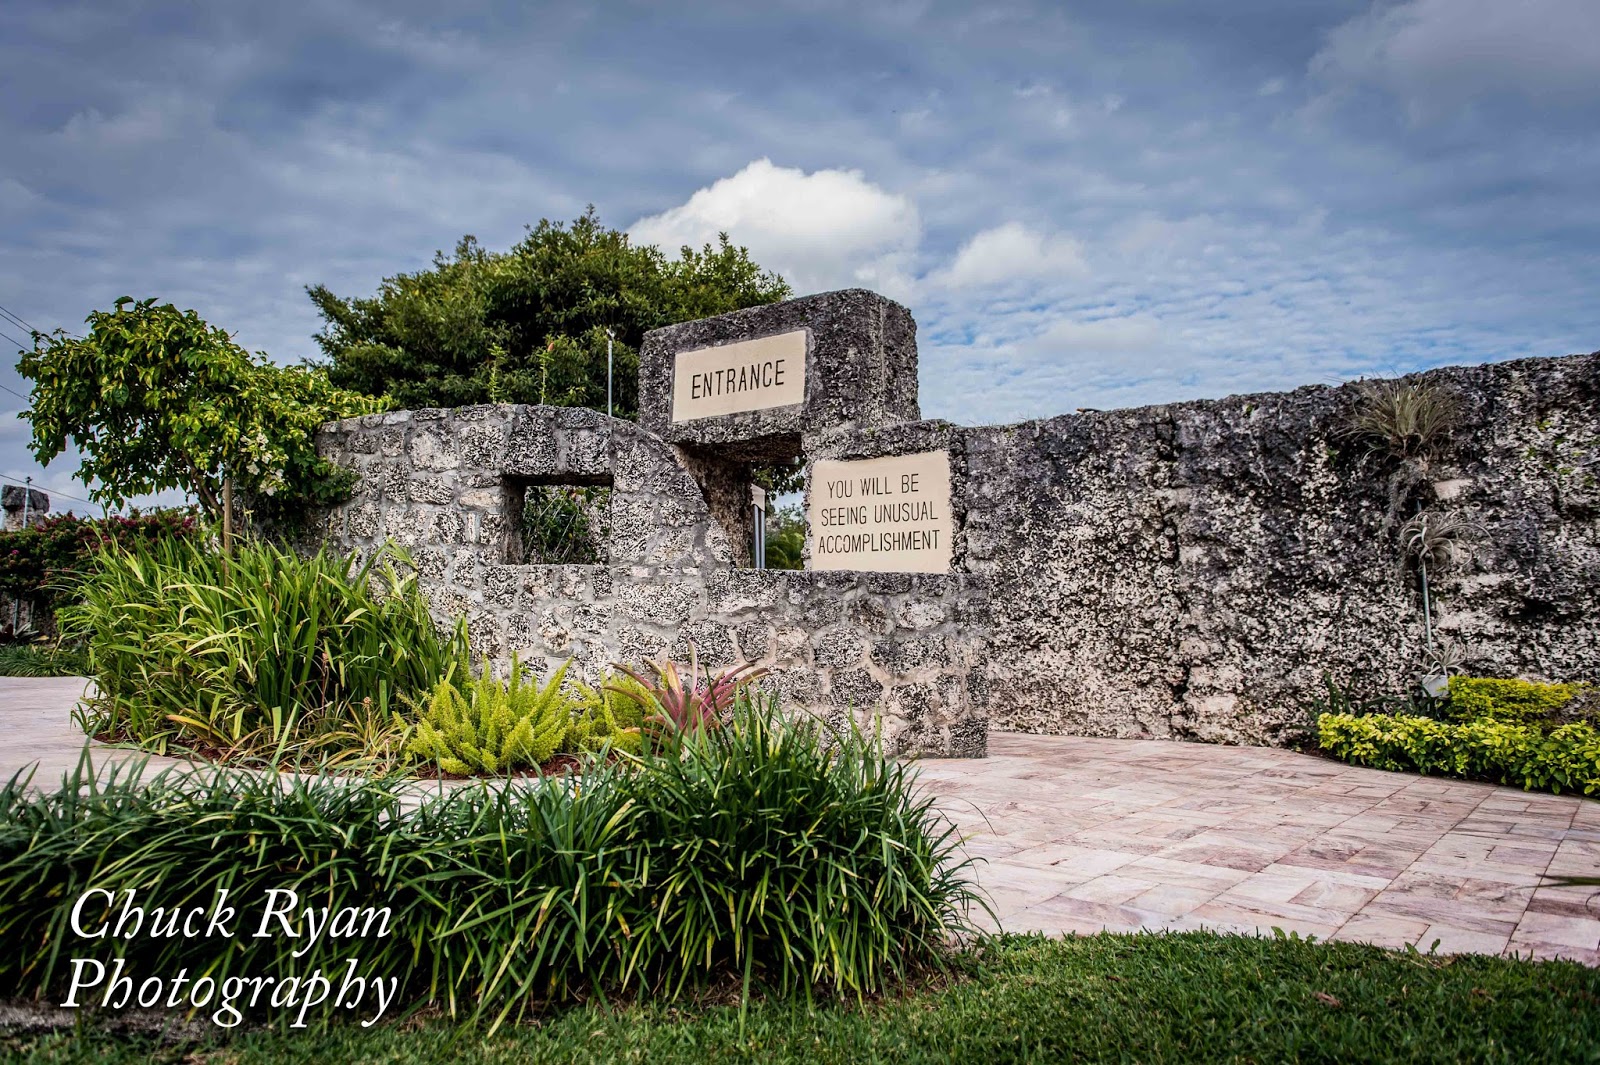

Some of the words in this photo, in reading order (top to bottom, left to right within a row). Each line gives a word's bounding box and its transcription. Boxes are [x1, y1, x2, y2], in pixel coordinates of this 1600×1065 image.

[691, 360, 785, 399] ENTRANCE
[827, 479, 853, 499] YOU
[860, 476, 892, 496] WILL
[901, 473, 919, 494] BE
[821, 506, 867, 527] SEEING
[874, 501, 938, 523] UNUSUAL
[818, 529, 940, 554] ACCOMPLISHMENT
